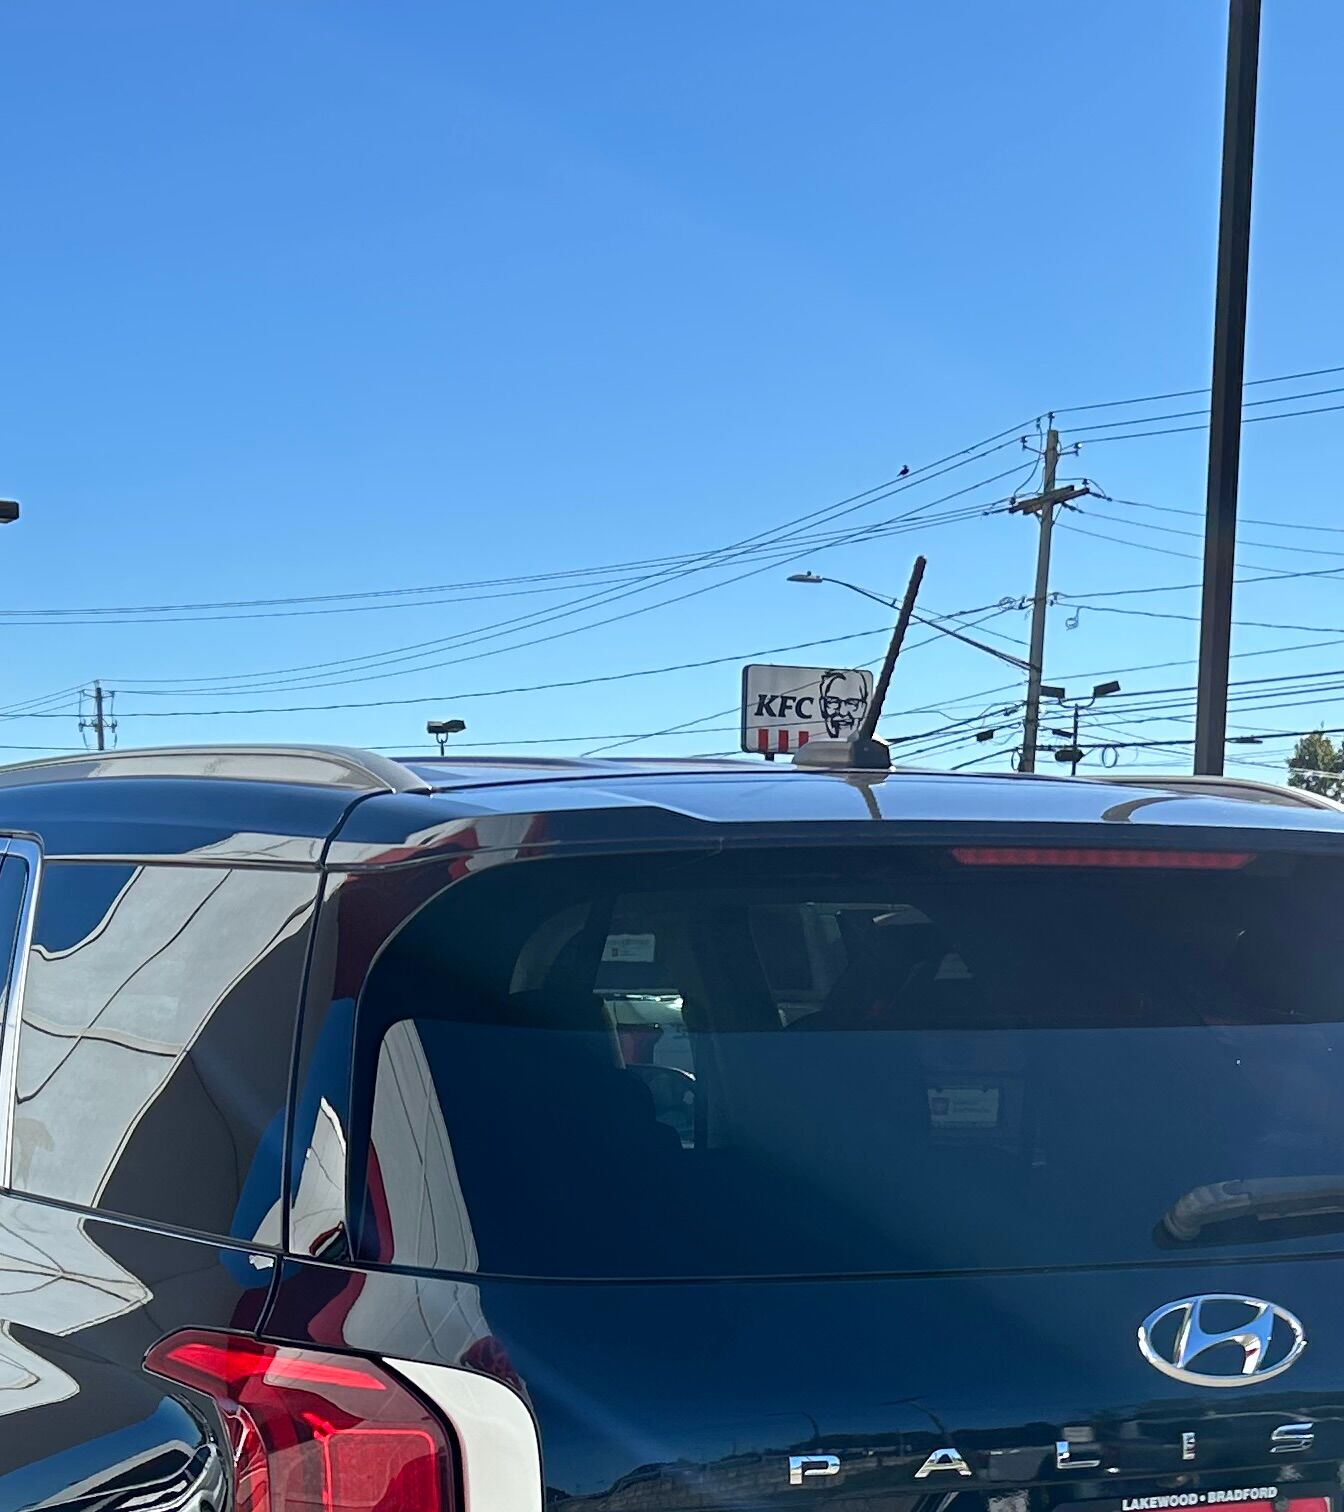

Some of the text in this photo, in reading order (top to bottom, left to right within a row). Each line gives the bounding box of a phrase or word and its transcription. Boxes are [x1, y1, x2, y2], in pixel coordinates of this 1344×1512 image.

[754, 693, 814, 719] KFC
[1122, 1486, 1278, 1511] LAKEWOOD BRADFORD
